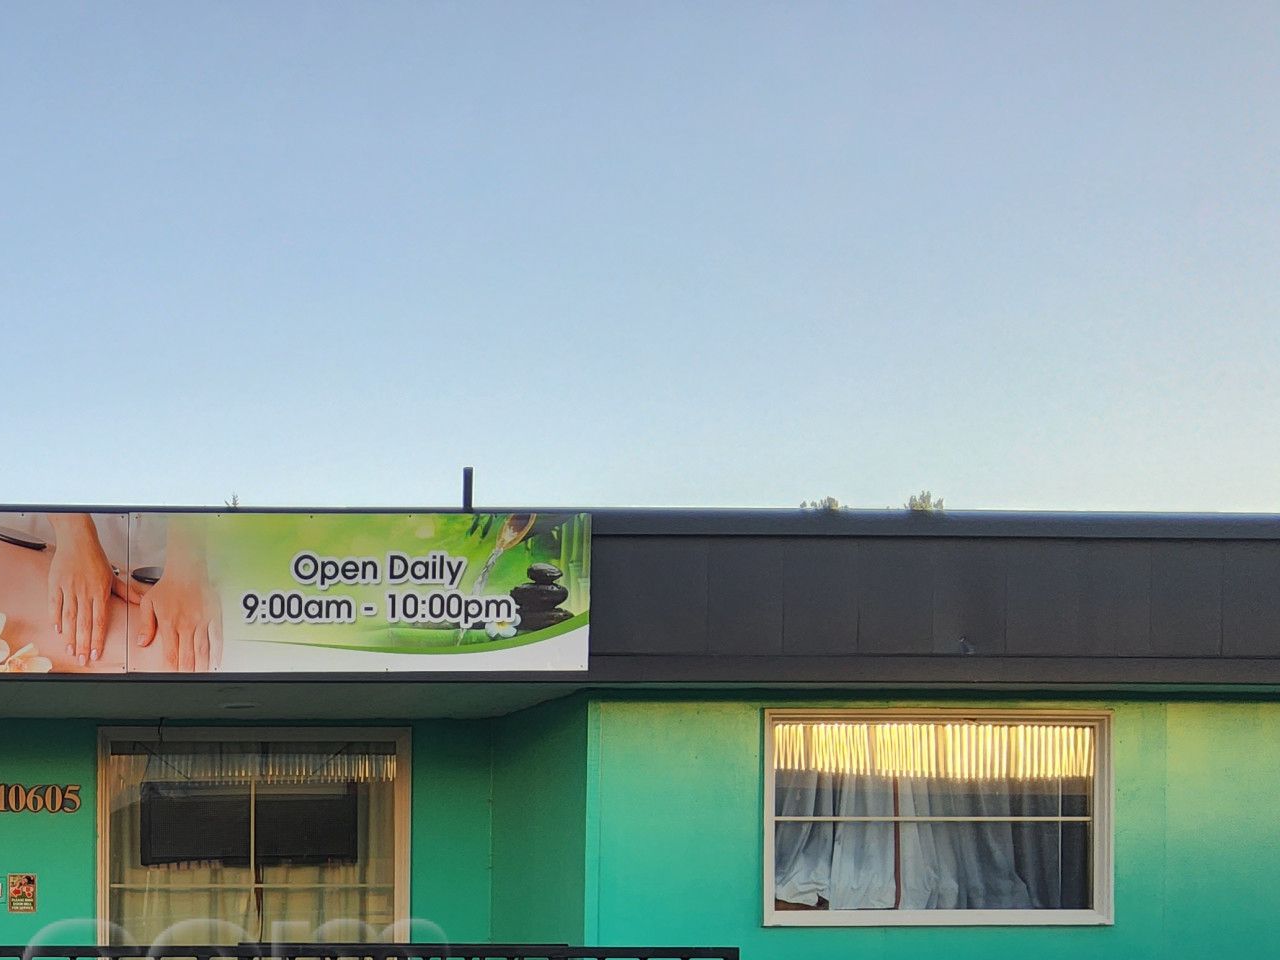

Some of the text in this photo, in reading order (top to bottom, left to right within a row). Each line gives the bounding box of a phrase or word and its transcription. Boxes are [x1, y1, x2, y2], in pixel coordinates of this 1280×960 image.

[293, 553, 464, 586] Open Daily
[241, 592, 353, 620] 9:00am
[387, 592, 513, 625] 10:00pm
